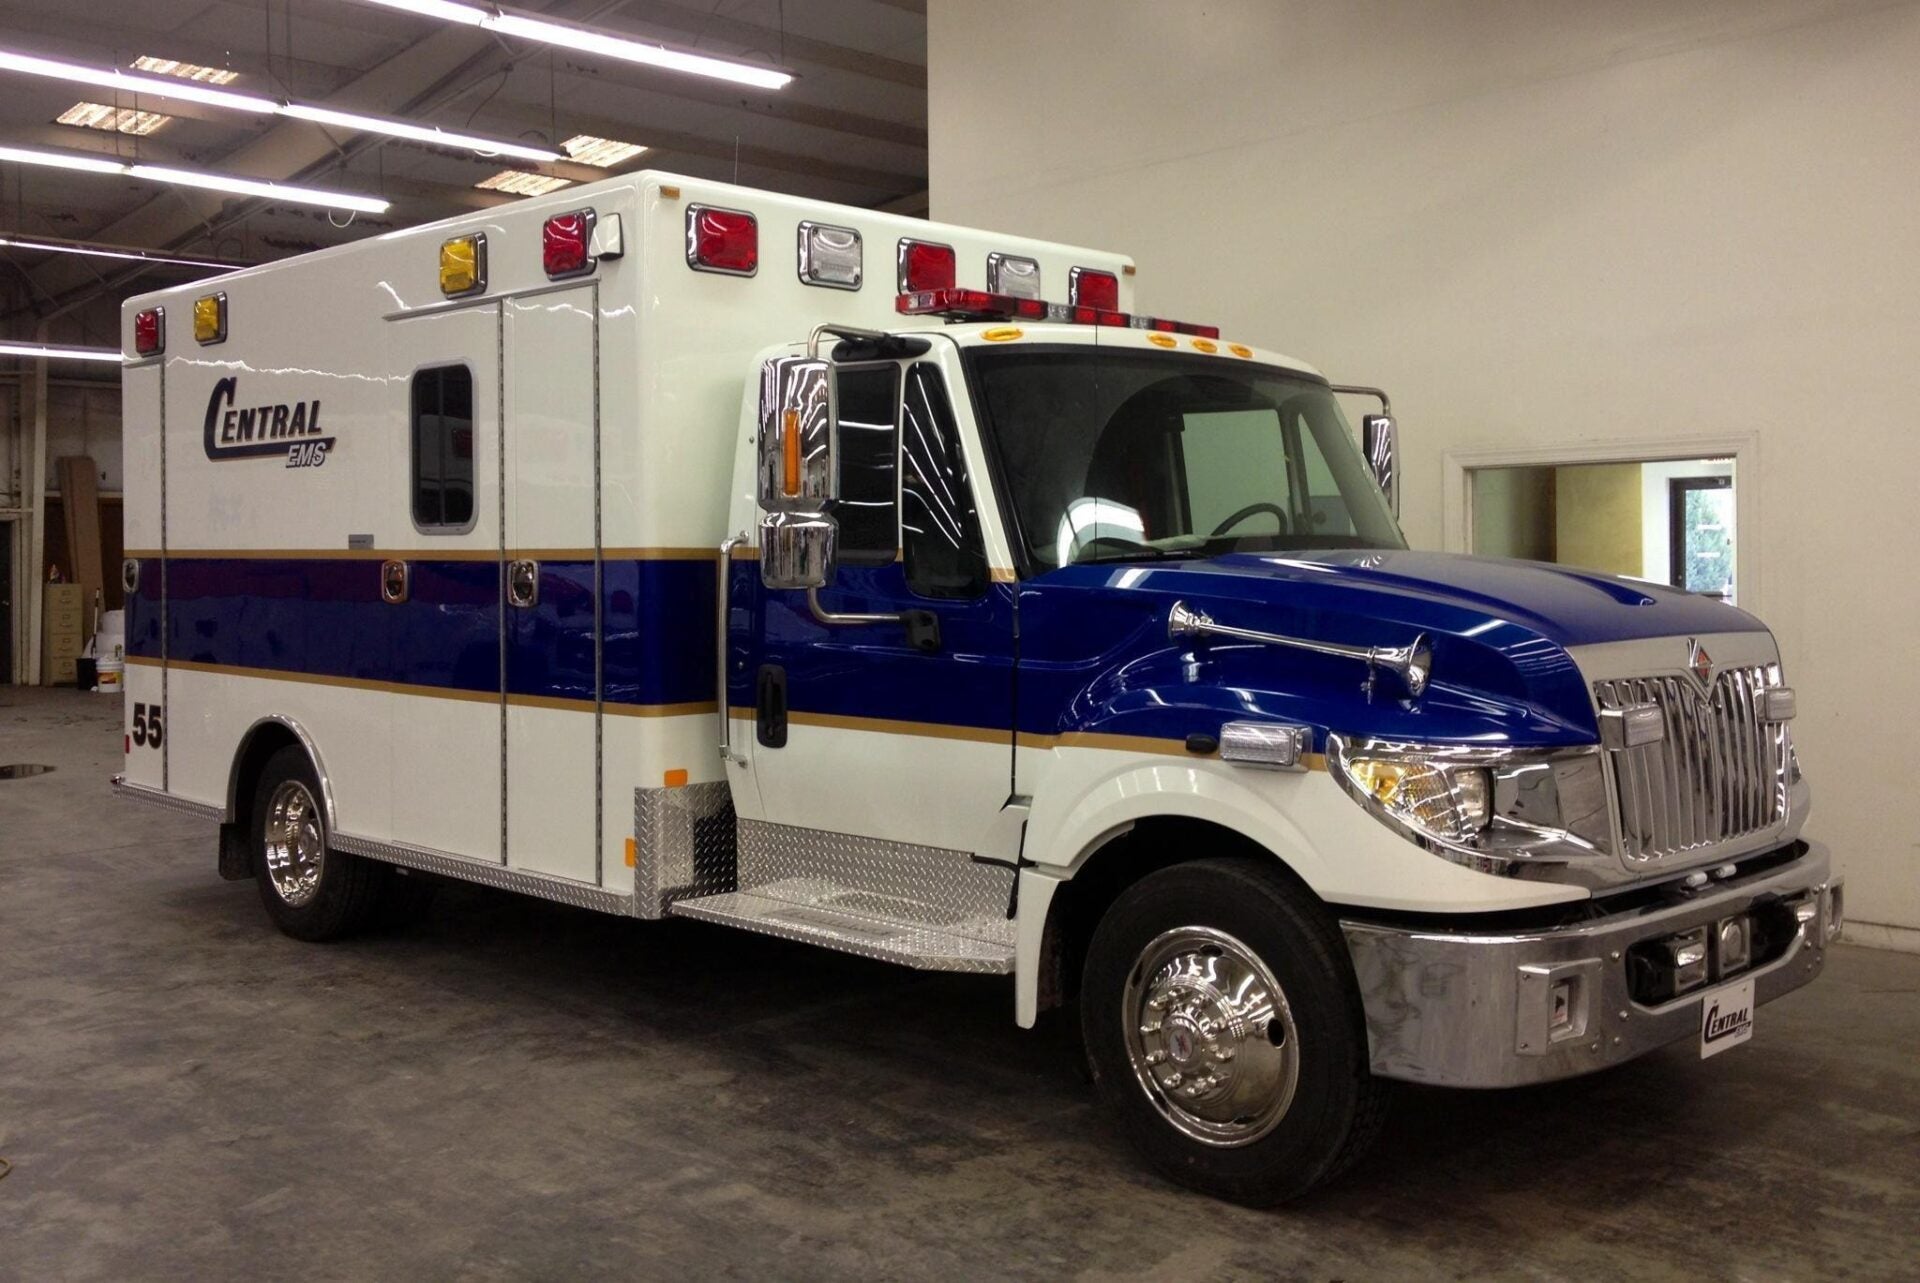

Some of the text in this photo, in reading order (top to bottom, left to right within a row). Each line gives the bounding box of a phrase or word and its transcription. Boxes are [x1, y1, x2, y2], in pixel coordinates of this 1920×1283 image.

[204, 377, 332, 462] CENTRAL
[286, 442, 326, 468] EMS
[132, 702, 163, 750] 55
[1704, 1004, 1750, 1044] CENTRAL
